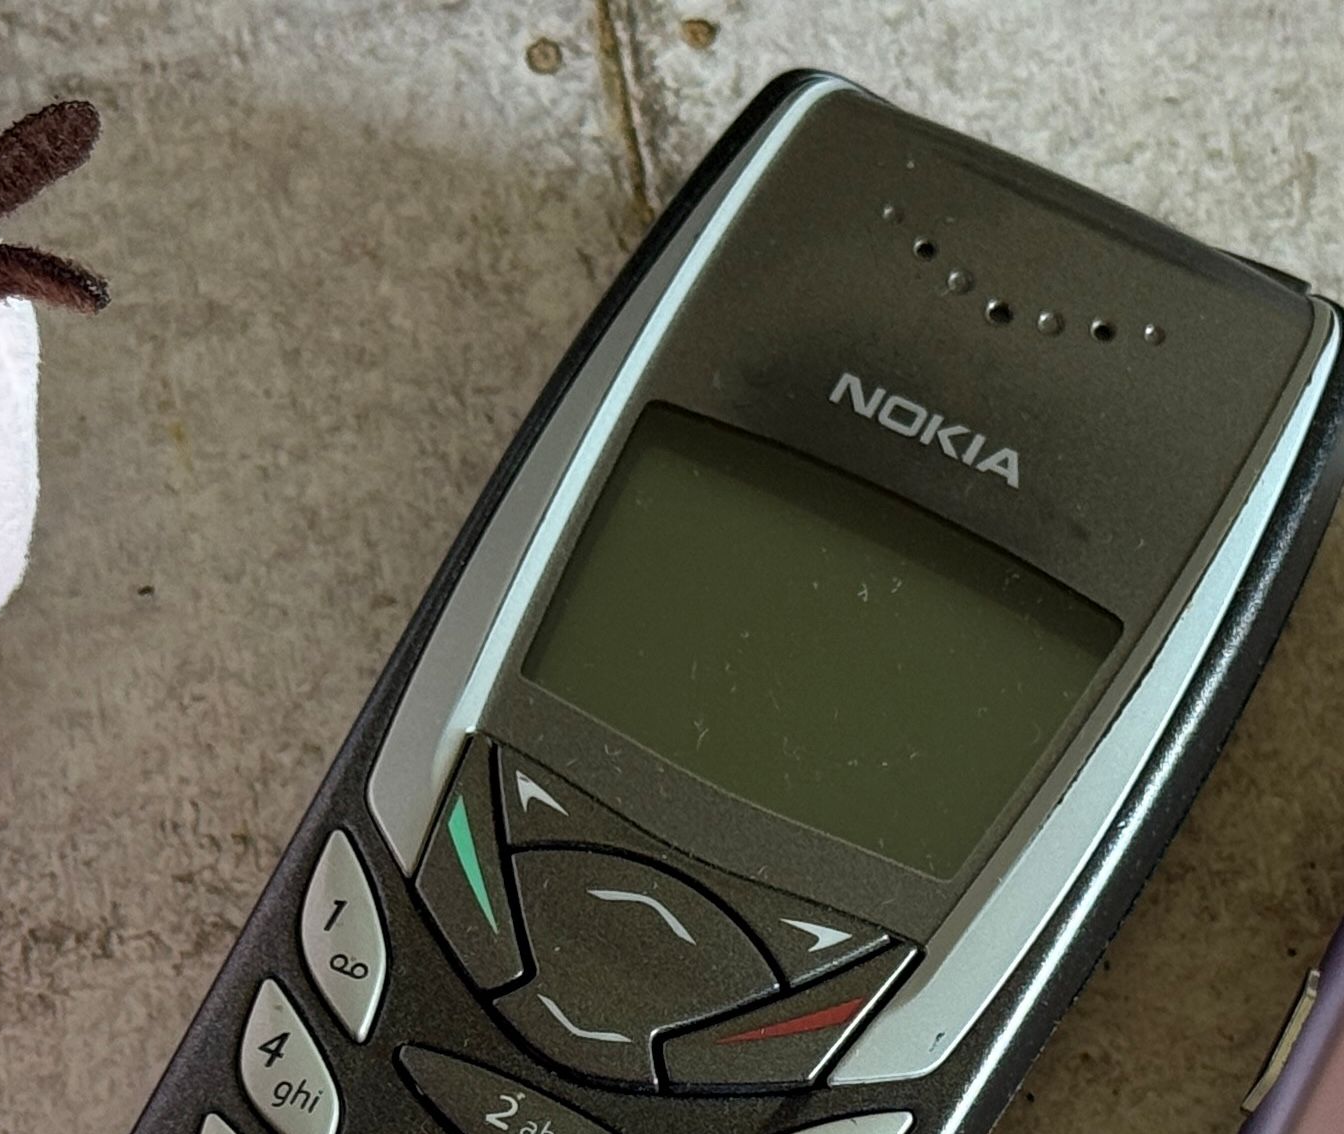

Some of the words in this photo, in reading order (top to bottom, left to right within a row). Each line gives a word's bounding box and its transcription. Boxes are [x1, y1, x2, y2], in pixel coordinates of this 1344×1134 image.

[828, 372, 1020, 489] NOKIA
[322, 899, 347, 933] 1
[257, 1031, 290, 1068] 4
[271, 1078, 322, 1116] ghi
[485, 1094, 518, 1131] 2
